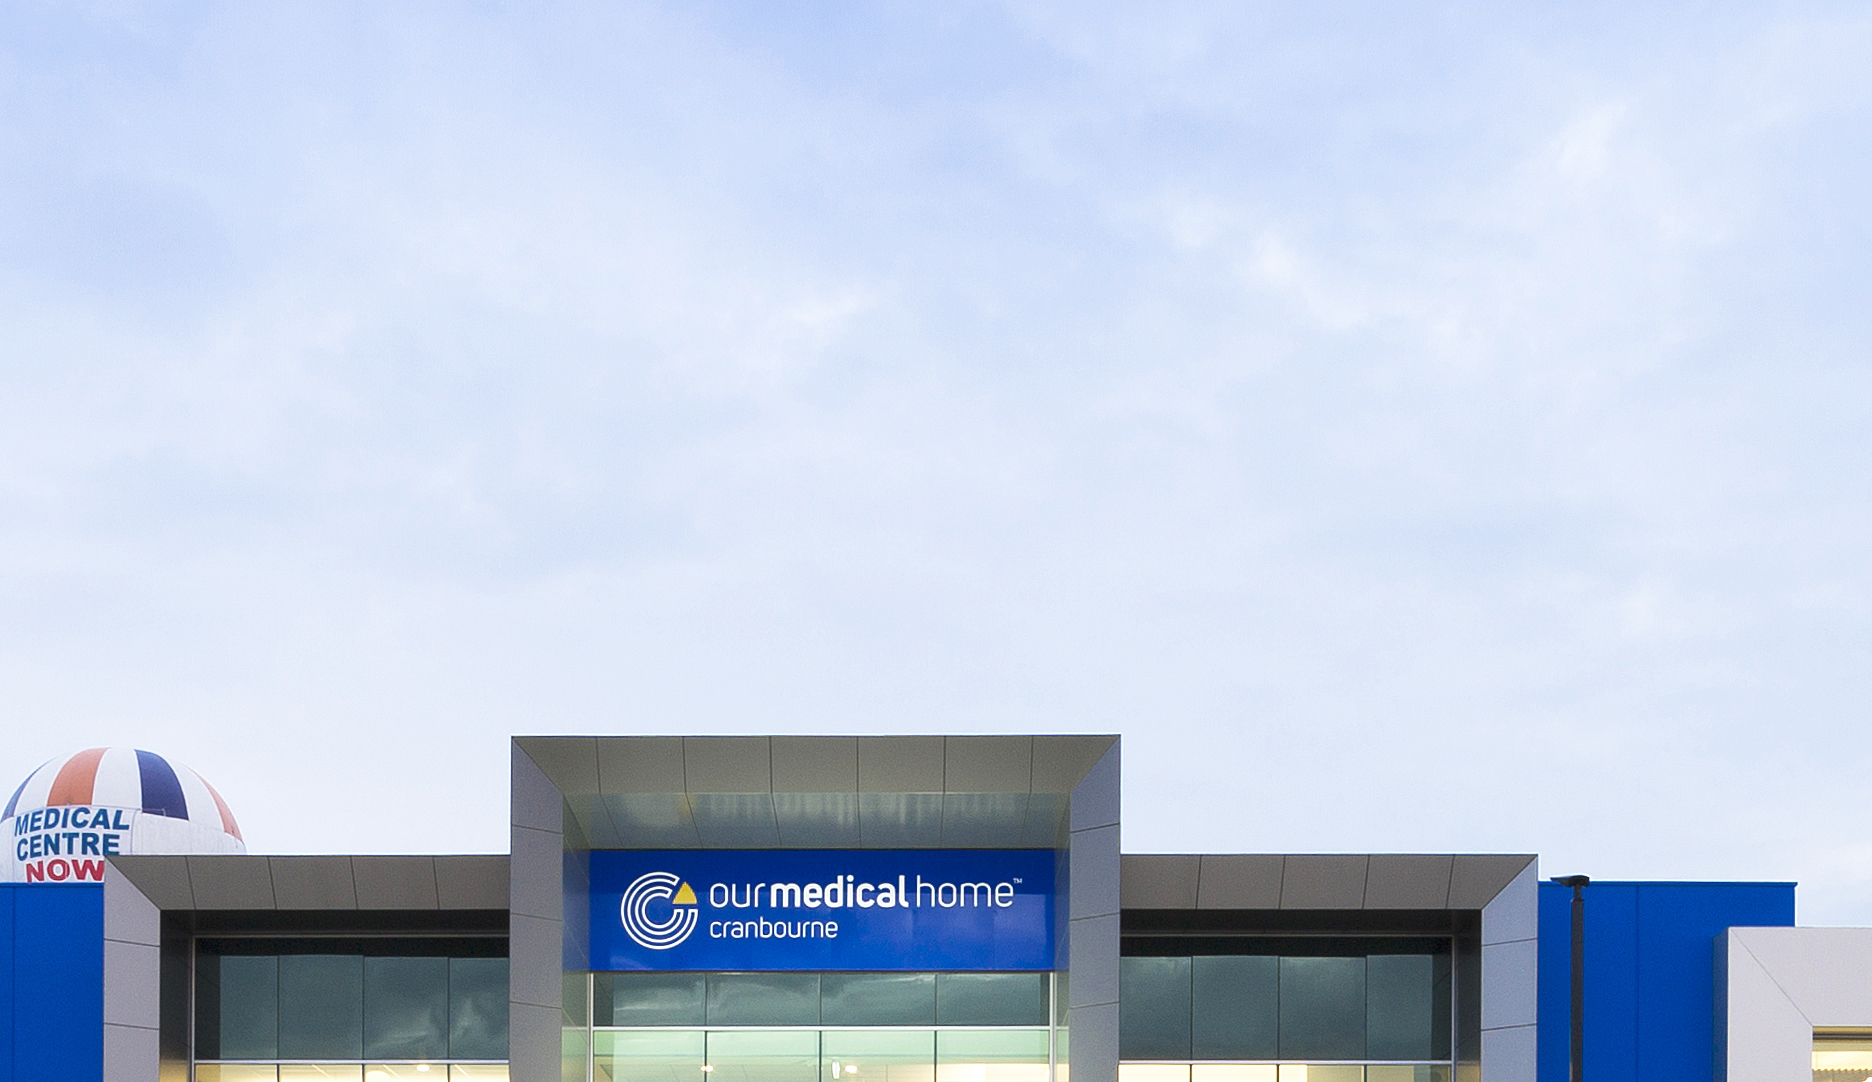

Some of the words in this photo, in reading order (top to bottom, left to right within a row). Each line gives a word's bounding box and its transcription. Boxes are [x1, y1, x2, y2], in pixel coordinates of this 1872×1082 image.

[15, 807, 130, 837] MEDICAL
[17, 832, 120, 861] CENTRE
[26, 859, 105, 882] NOW
[709, 916, 838, 938] cranbourne
